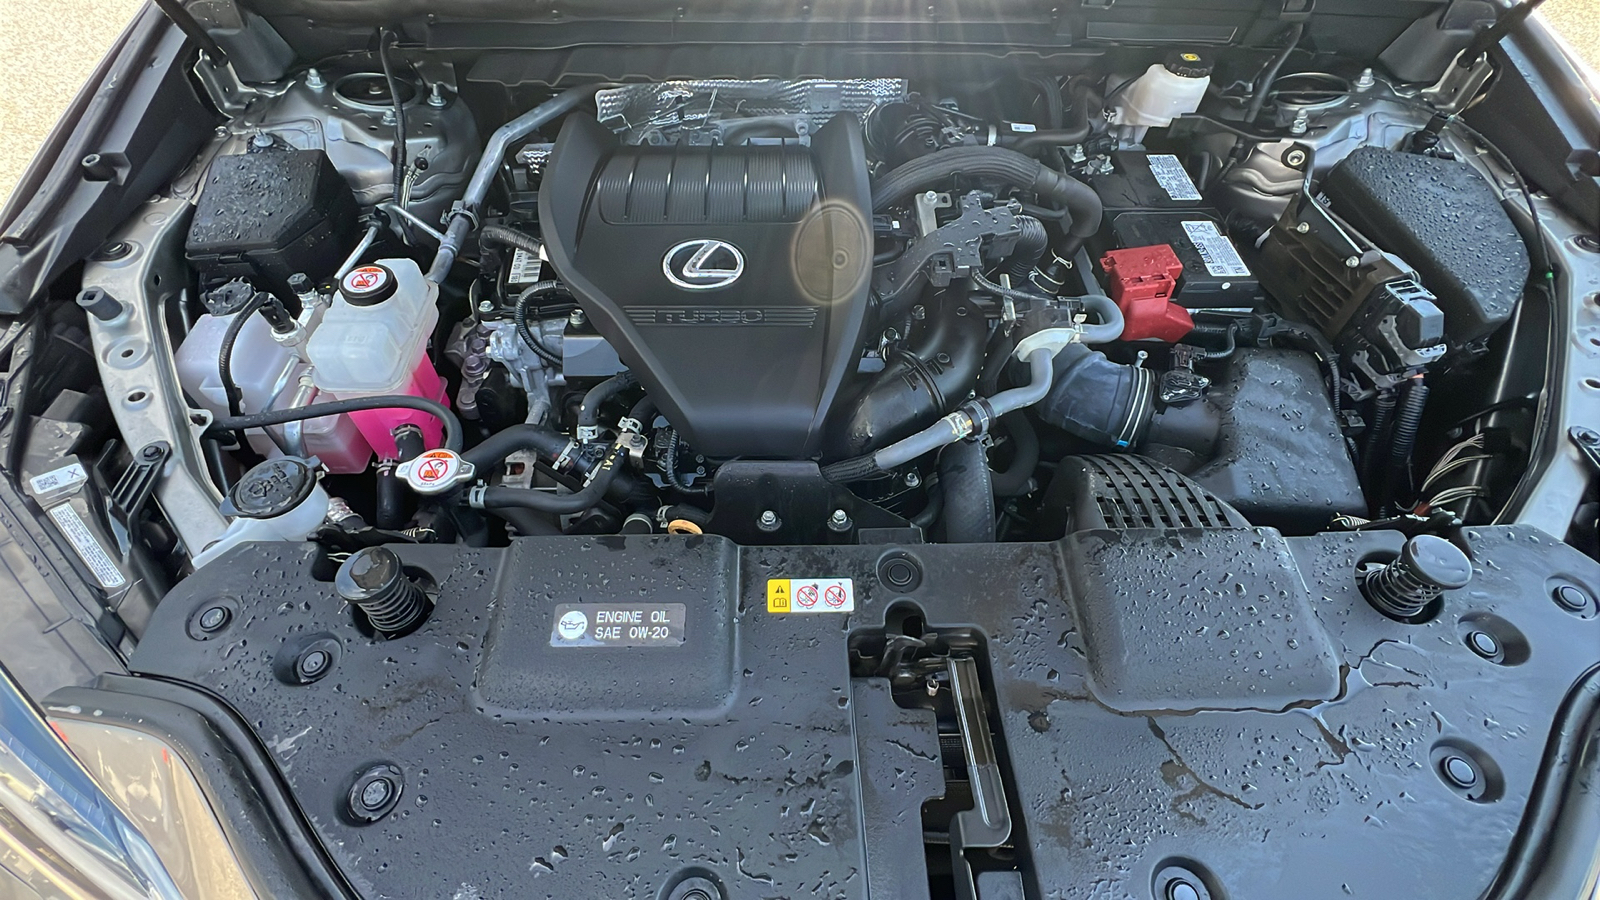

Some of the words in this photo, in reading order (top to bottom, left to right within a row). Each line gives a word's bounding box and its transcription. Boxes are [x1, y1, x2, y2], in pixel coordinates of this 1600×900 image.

[657, 309, 763, 324] TURBO
[596, 611, 644, 623] ENGINE
[650, 611, 670, 623] OIL
[594, 626, 621, 639] SAE
[629, 626, 669, 639] 0W-20
